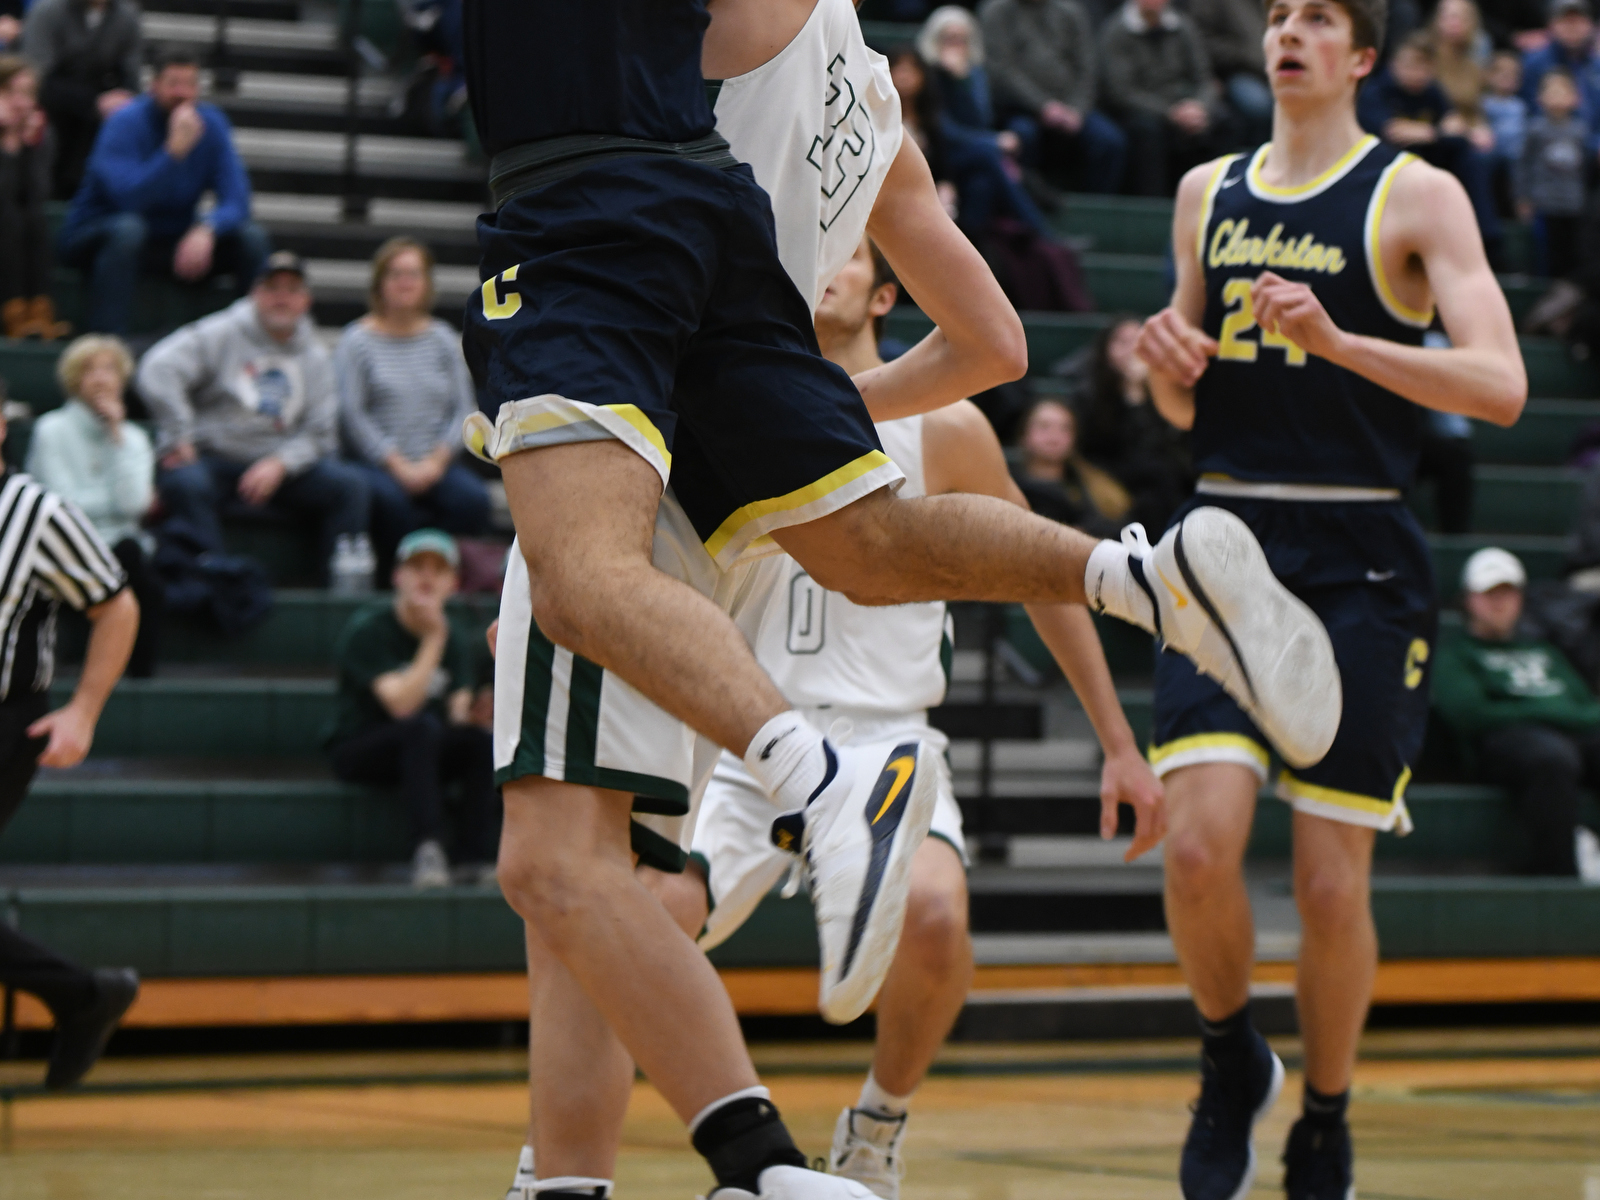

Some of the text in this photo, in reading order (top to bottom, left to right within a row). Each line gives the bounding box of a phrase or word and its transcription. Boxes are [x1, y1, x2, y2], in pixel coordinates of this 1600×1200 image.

[1208, 217, 1346, 274] Clarkston
[481, 263, 523, 322] C
[1403, 637, 1430, 690] C
